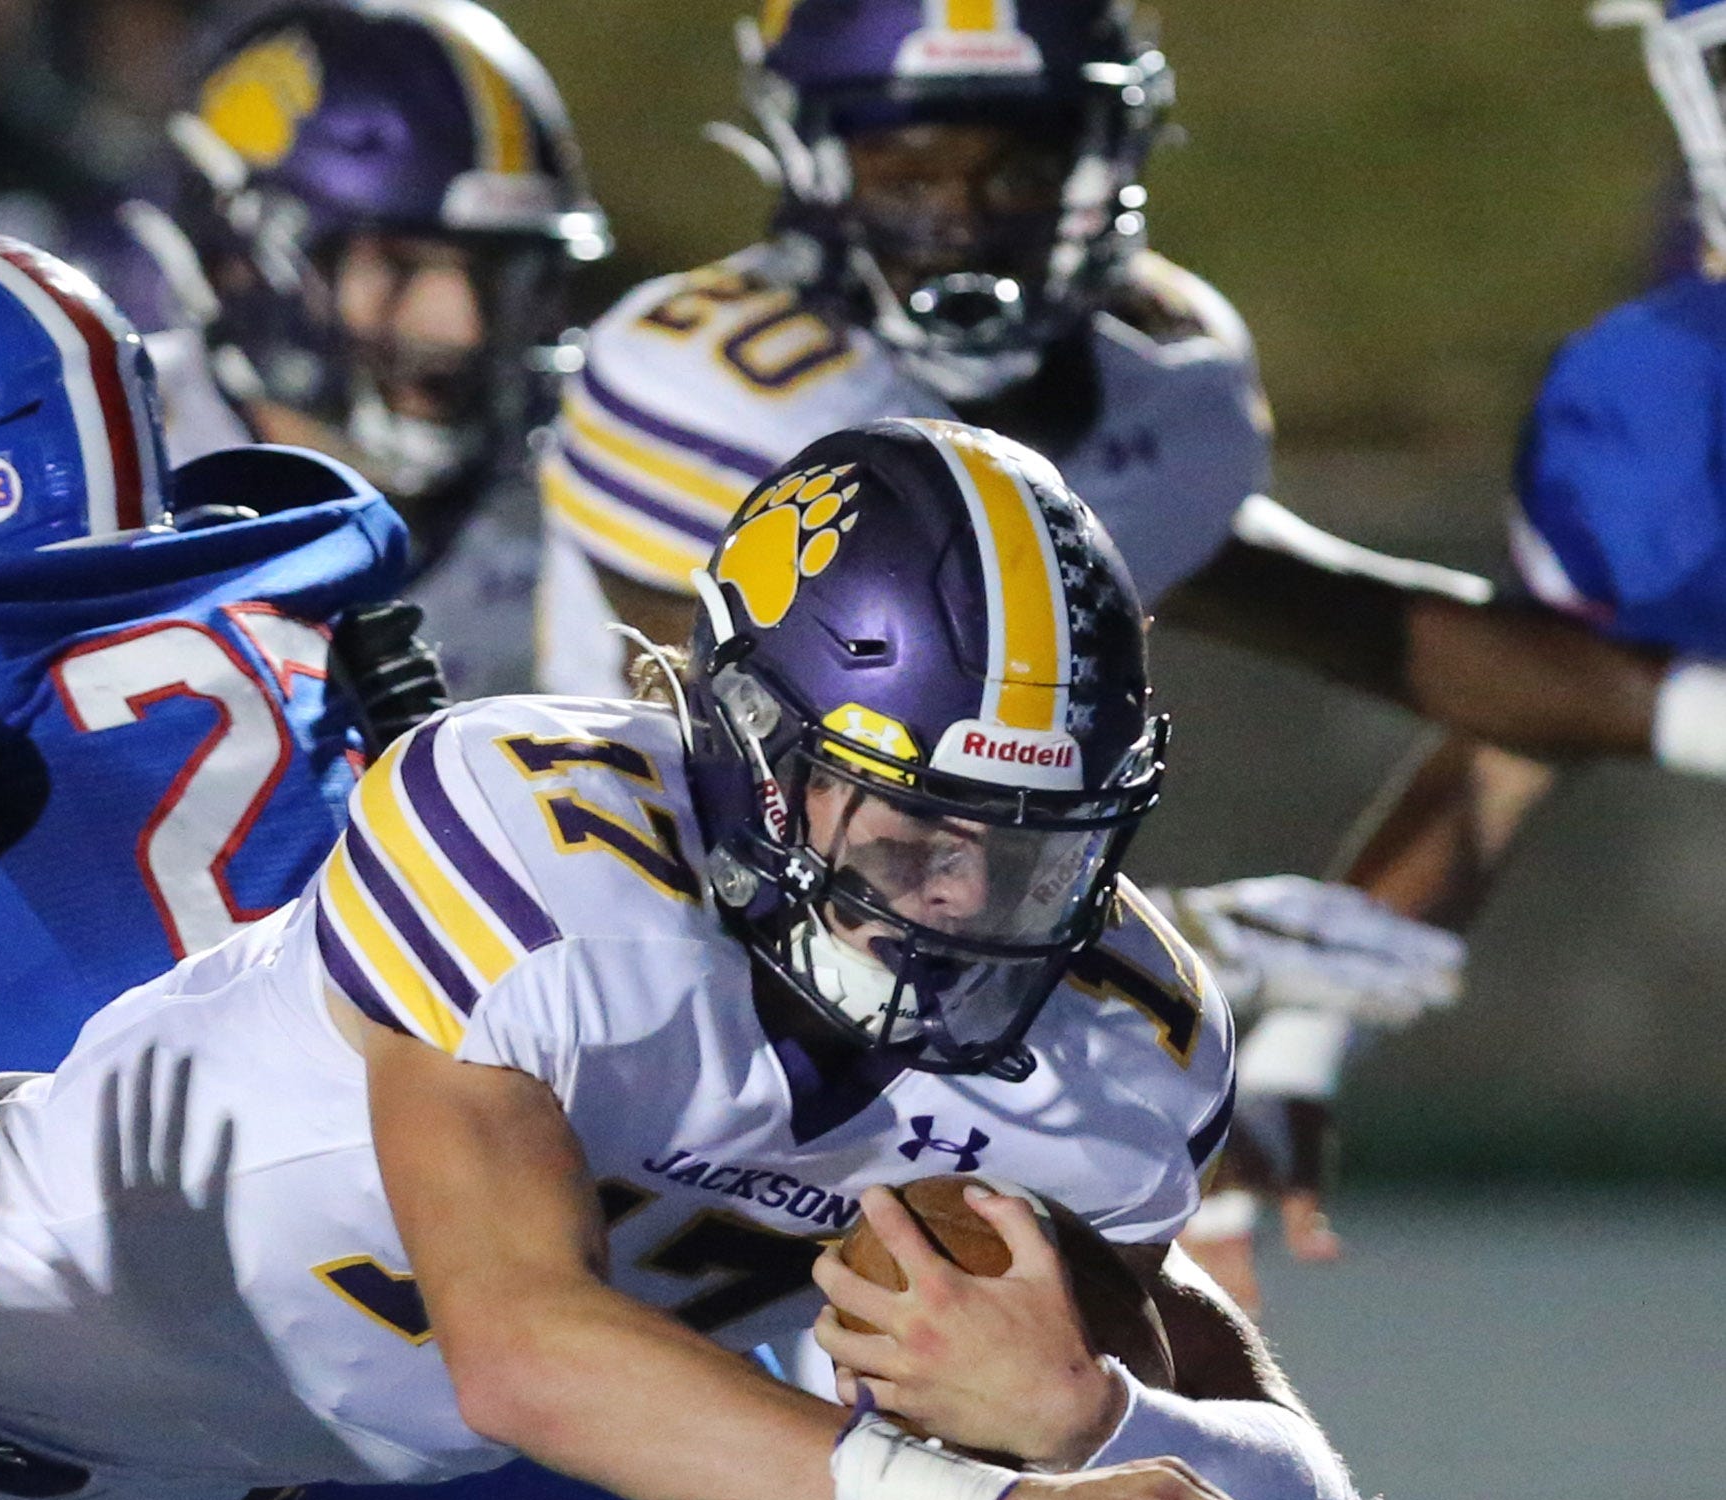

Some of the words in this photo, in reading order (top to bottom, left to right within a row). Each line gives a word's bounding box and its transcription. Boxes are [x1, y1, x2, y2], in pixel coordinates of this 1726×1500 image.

[49, 601, 334, 962] 2
[962, 731, 1073, 768] Riddell
[491, 732, 705, 906] 17
[641, 1150, 862, 1229] JACKSON
